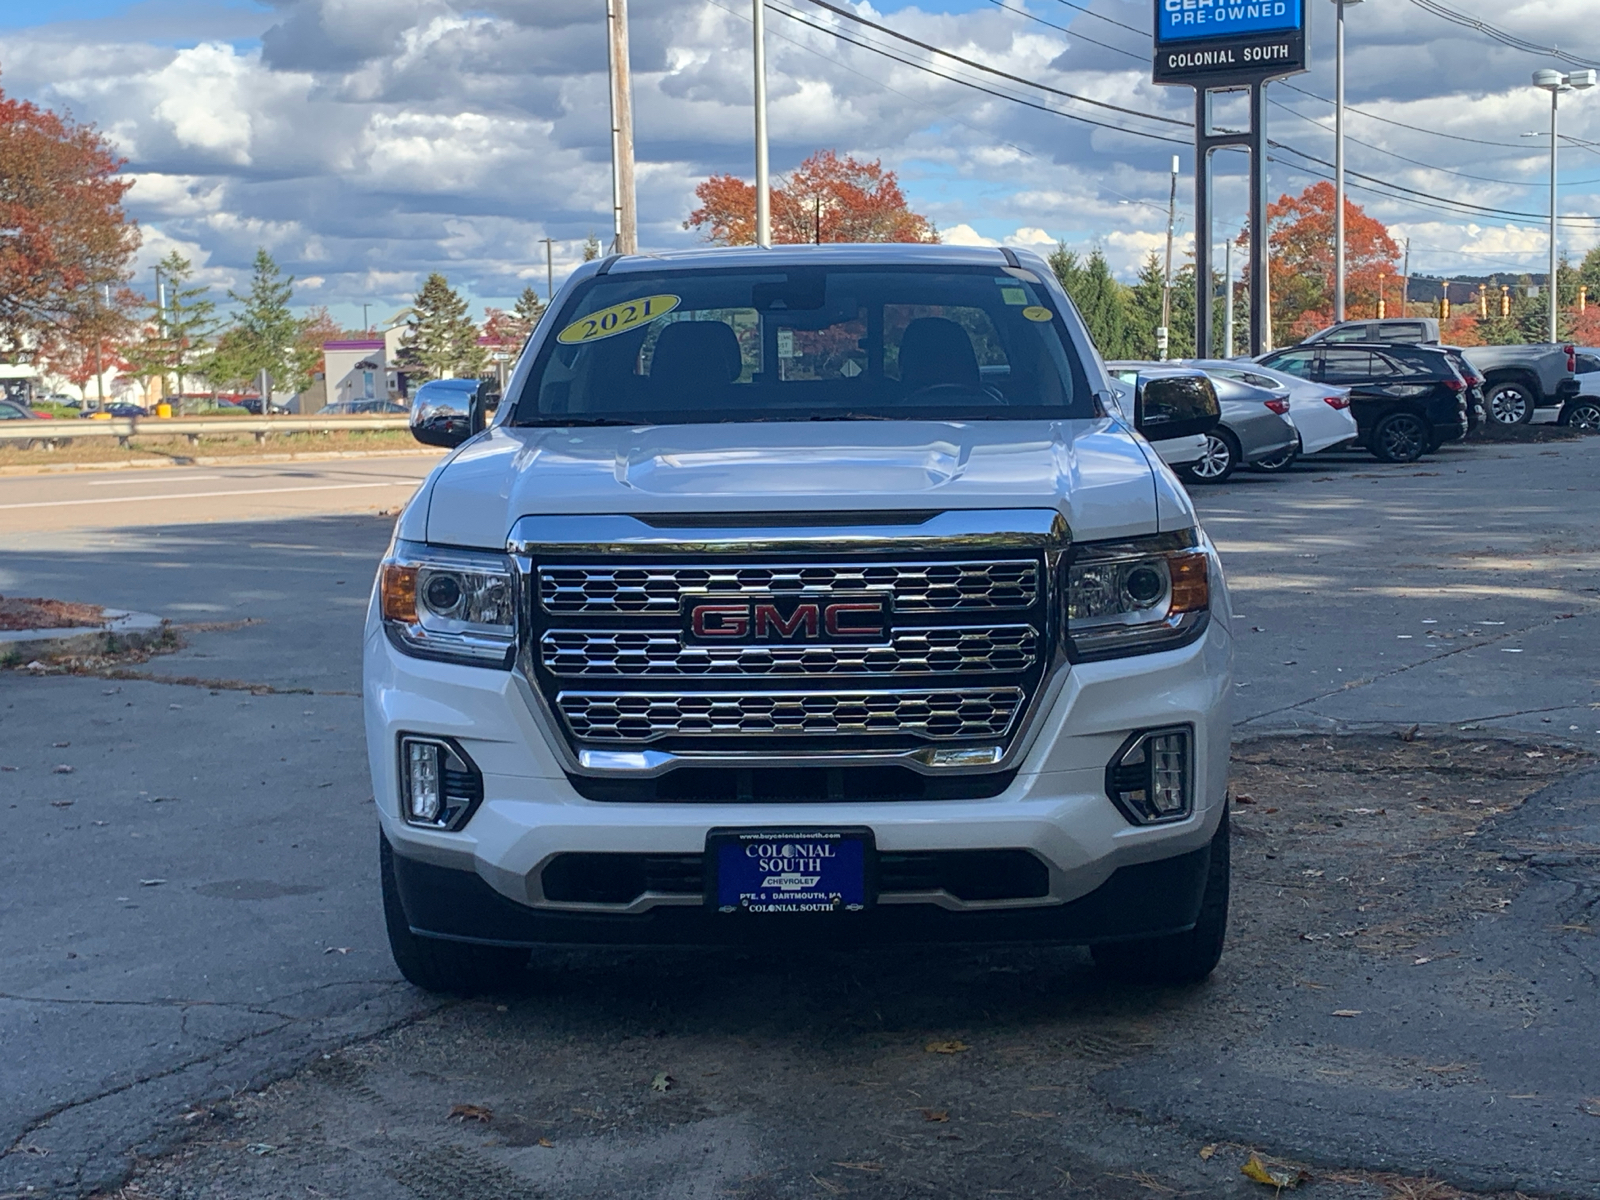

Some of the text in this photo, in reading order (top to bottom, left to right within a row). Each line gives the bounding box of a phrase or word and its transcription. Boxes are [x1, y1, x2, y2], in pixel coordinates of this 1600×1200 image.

[1171, 2, 1286, 26] PRE-OWNED
[1168, 44, 1289, 68] COLONIAL SOUTH
[581, 299, 654, 339] 2021
[691, 602, 884, 638] GMC
[739, 832, 841, 841] www.buycolonialsouth.com
[745, 843, 836, 858] COLONIAL
[759, 858, 821, 872] SOUTH
[767, 877, 814, 885] CHEVROLET
[772, 892, 828, 900] DARTMOUTH,
[749, 903, 834, 913] COLONIAL SOUTH
